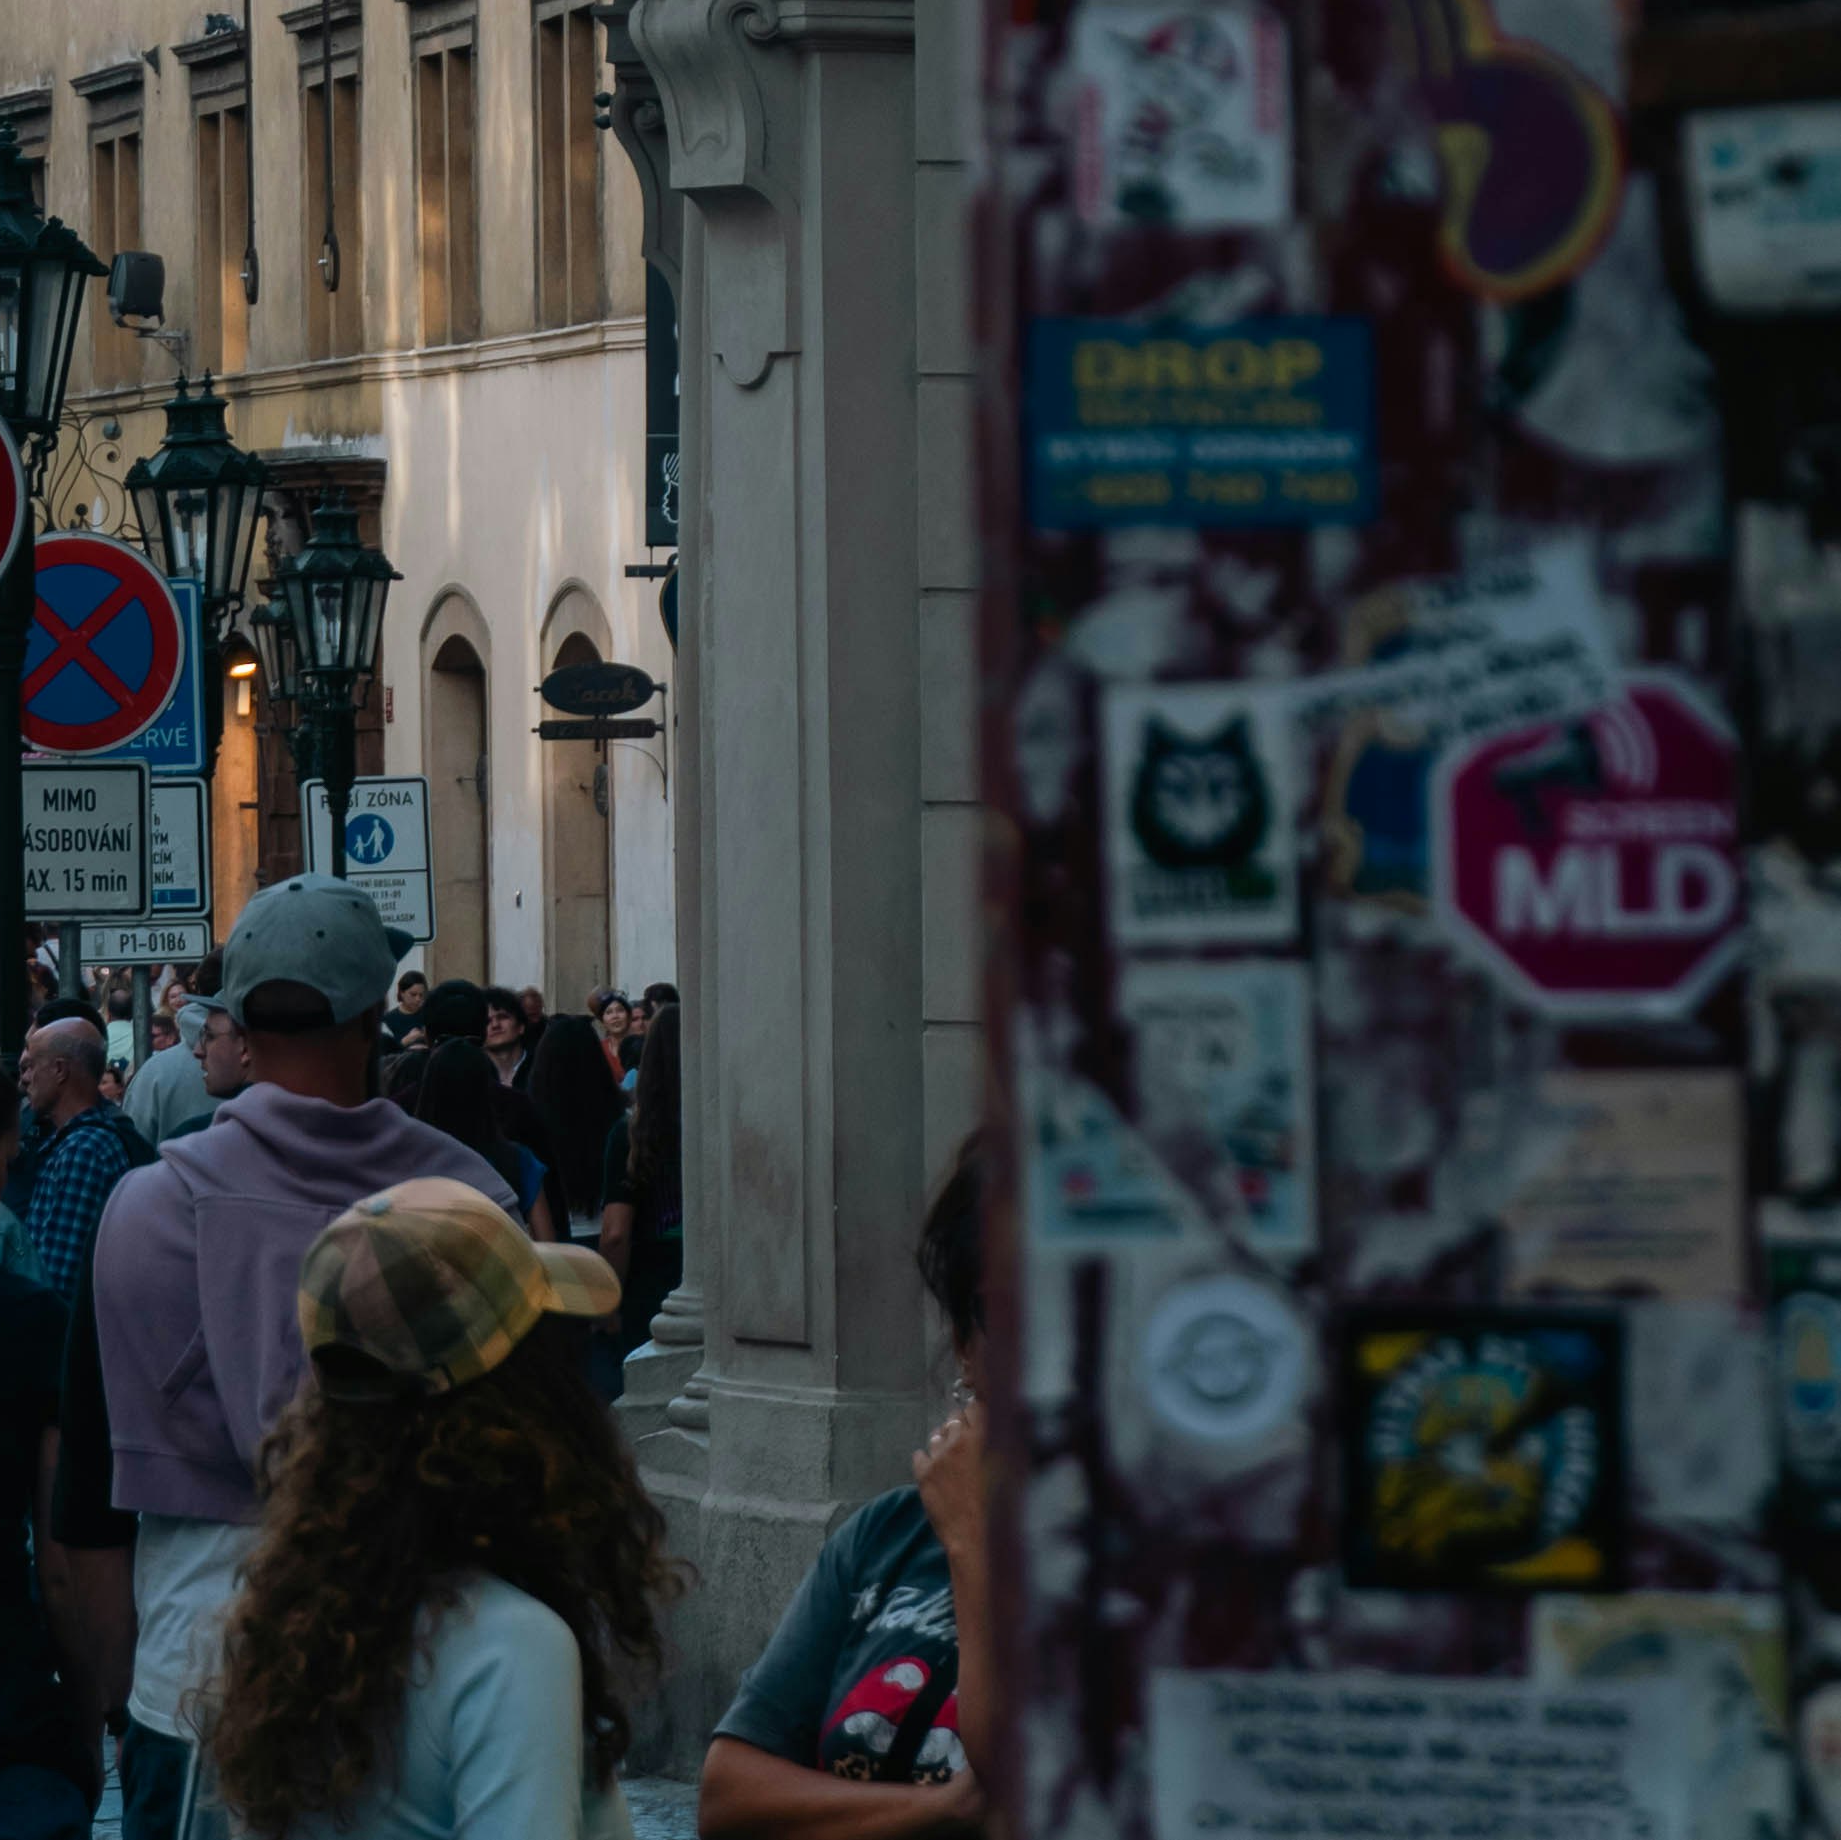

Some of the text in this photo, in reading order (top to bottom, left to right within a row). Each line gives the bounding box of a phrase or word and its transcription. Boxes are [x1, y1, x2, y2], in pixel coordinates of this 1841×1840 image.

[1072, 338, 1324, 391] DROP
[129, 721, 189, 749] ERVÉ
[43, 788, 97, 812] MIMO
[367, 788, 414, 807] ZÓNA
[23, 823, 134, 854] ÁSOBOVÁNÍ
[25, 868, 128, 893] AX. 15 min
[1491, 844, 1738, 937] MLD
[119, 932, 187, 953] P1-0186
